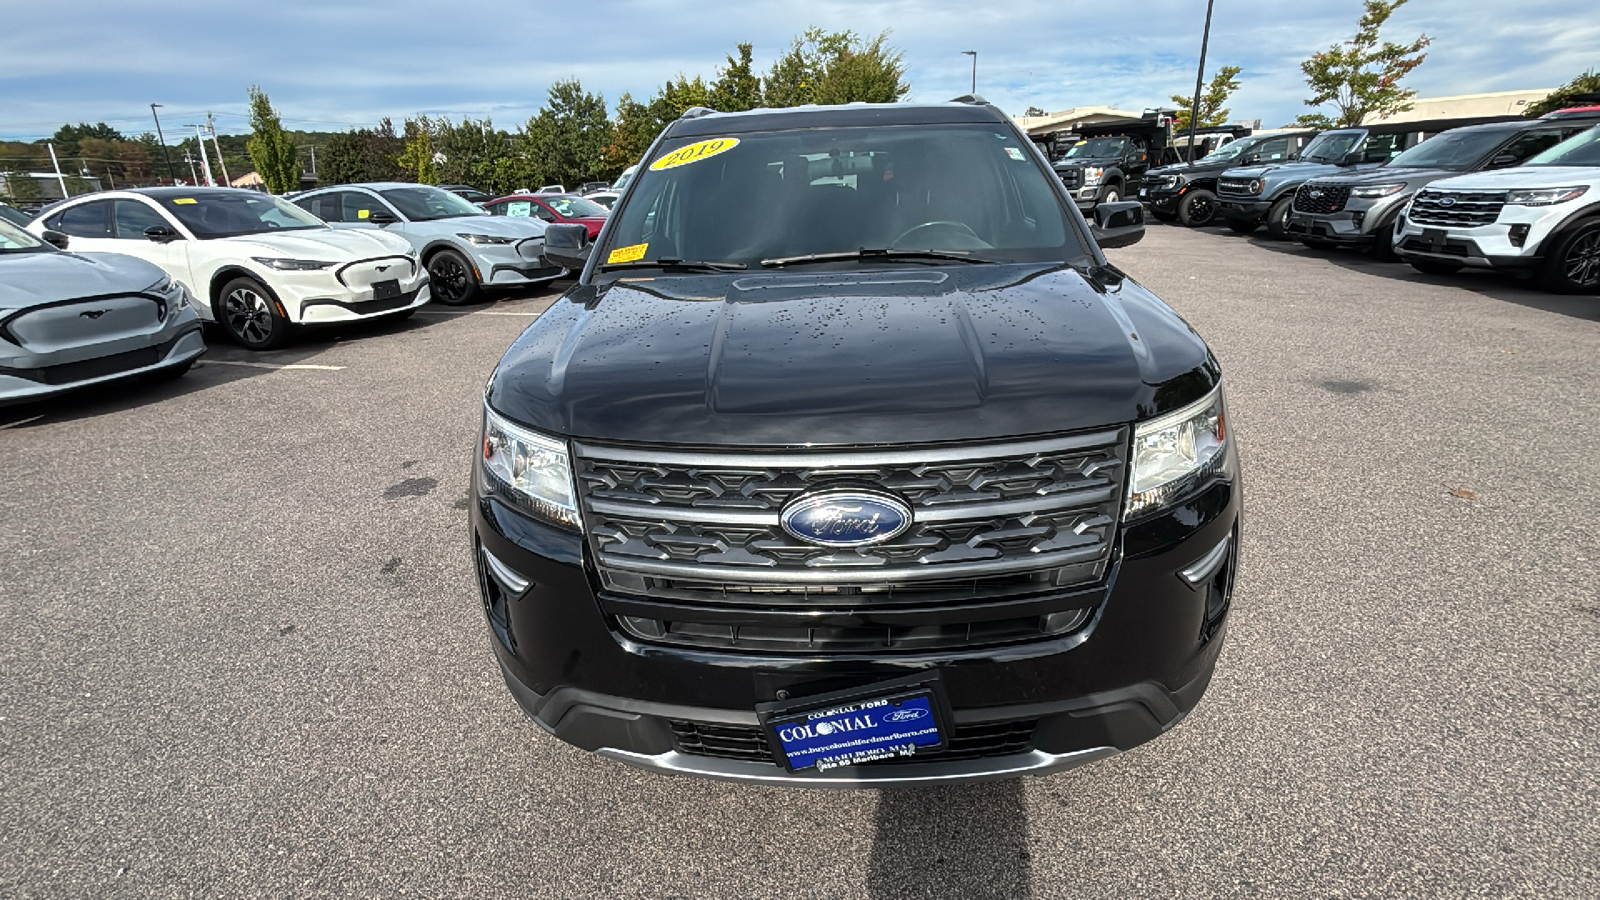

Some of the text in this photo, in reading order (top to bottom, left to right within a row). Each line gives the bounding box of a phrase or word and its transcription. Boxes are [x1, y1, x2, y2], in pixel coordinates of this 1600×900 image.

[664, 140, 725, 167] 2019
[811, 504, 880, 536] Ford
[808, 699, 889, 721] COLONIAL FORD
[892, 710, 919, 721] Ford
[780, 714, 878, 743] COLONIAL
[786, 727, 938, 757] www.buycolonialfordmarlboro.com
[852, 752, 895, 764] Marlboro
